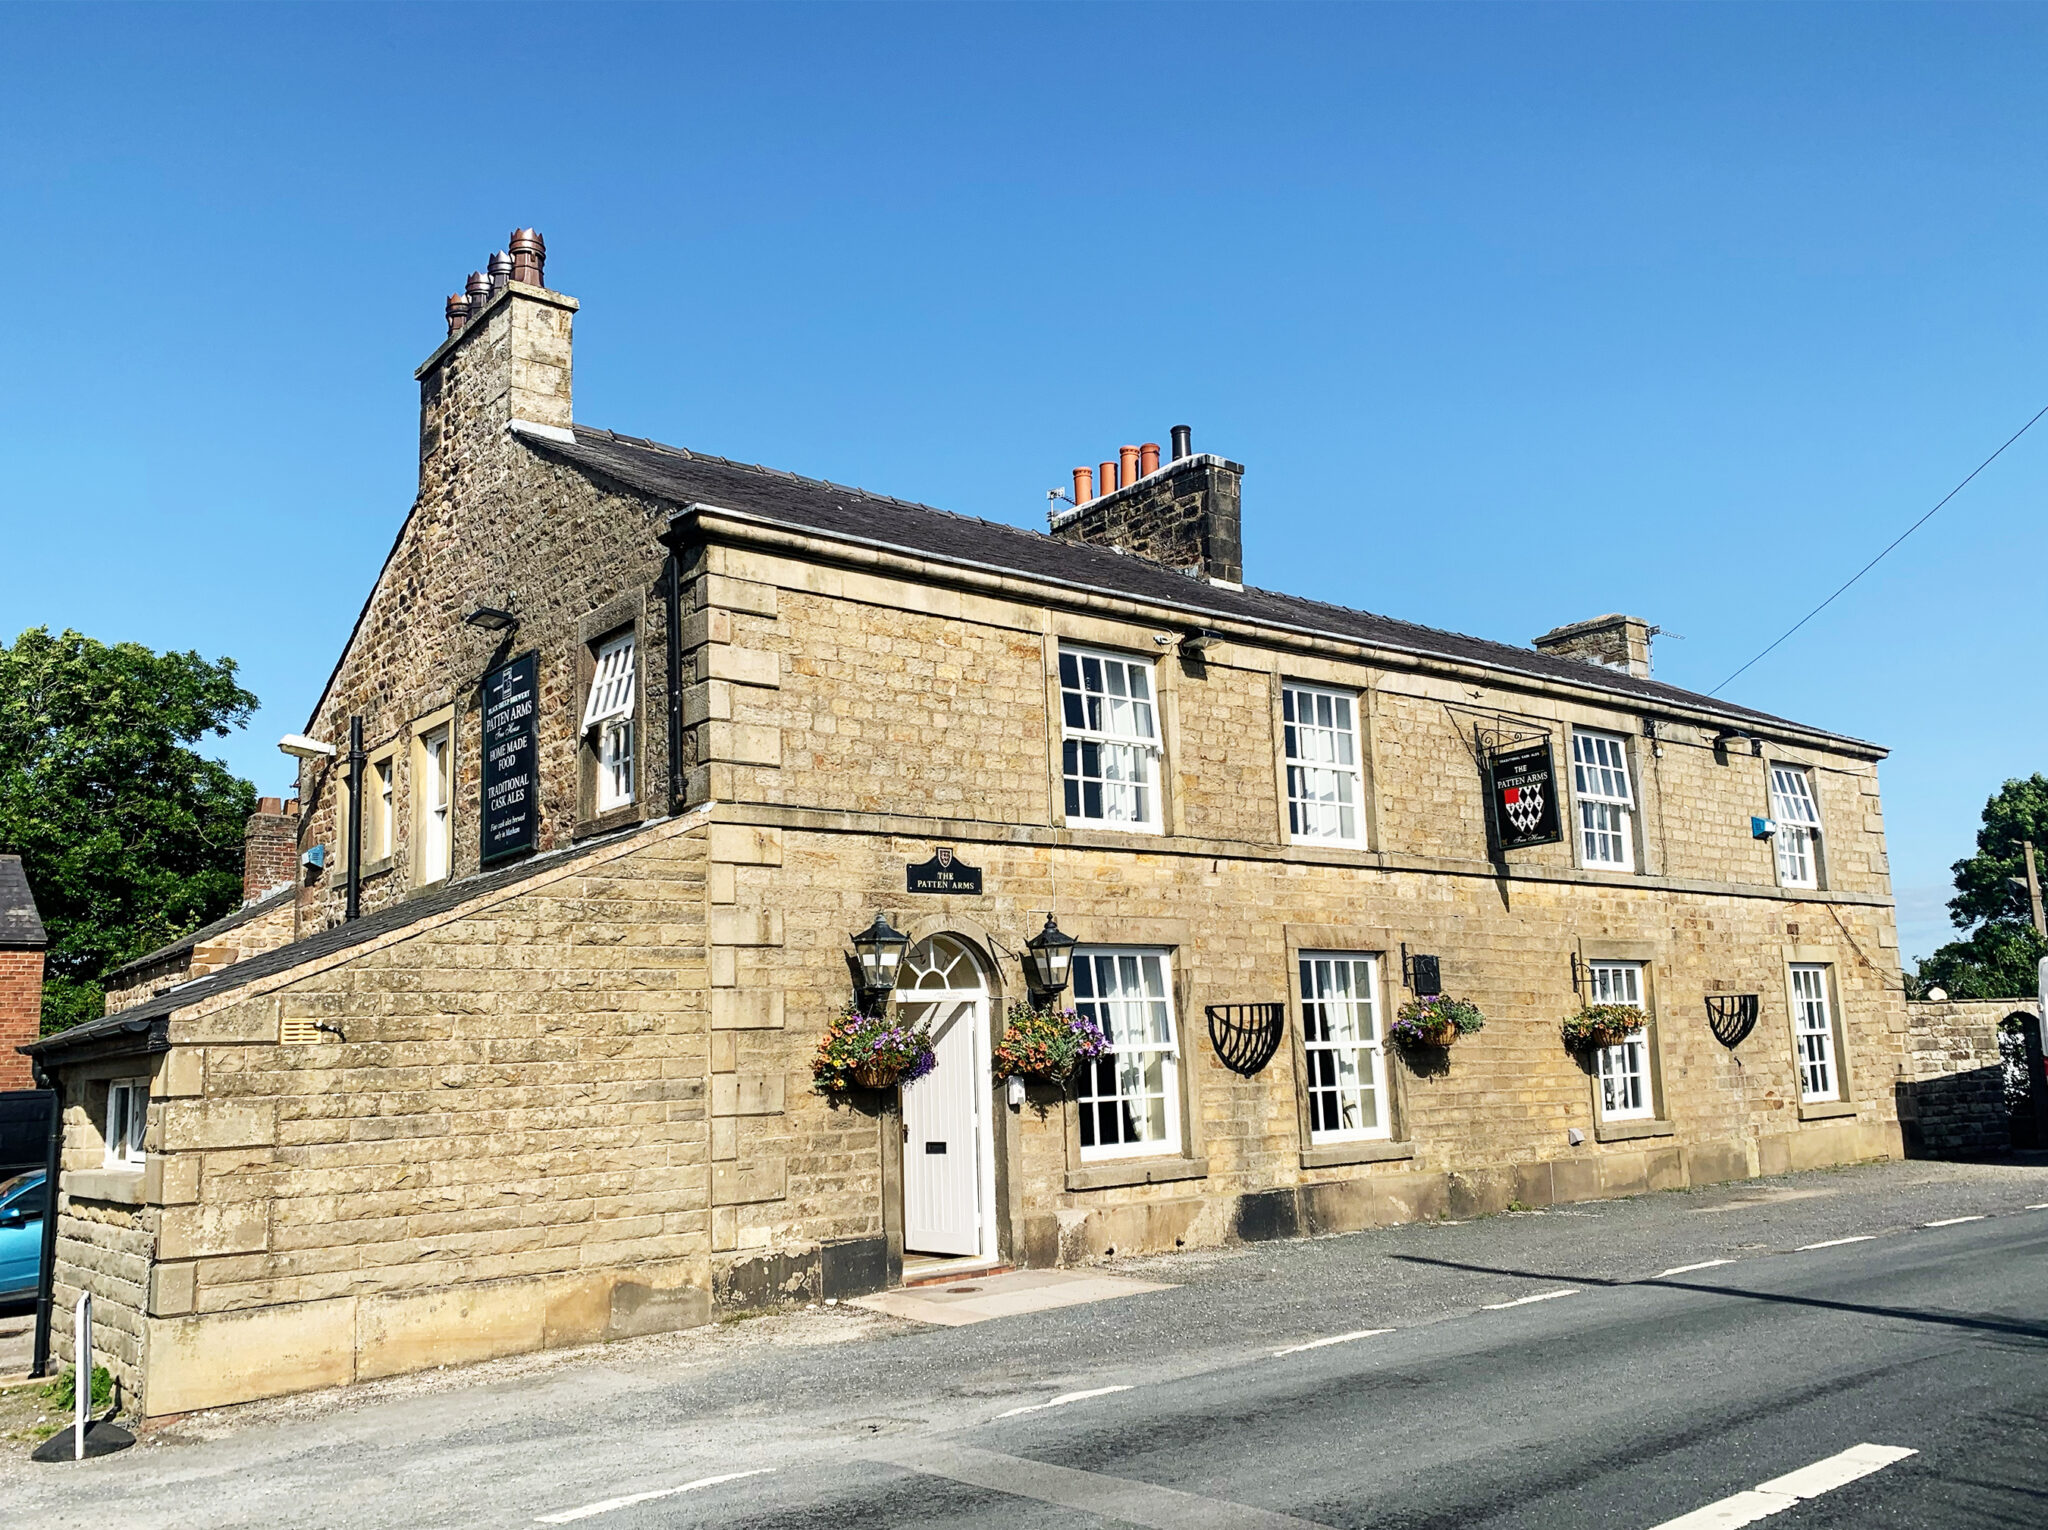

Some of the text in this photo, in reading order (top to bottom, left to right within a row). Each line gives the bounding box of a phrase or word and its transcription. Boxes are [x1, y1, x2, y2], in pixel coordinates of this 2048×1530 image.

[486, 700, 532, 733] PATTEN ARMS
[489, 736, 528, 762] HOME MADE
[498, 754, 516, 772] FOOD
[1514, 764, 1527, 773] THE
[488, 773, 529, 799] TRADITIONAL
[1497, 771, 1548, 789] PATTEN ARMS
[491, 788, 525, 811] CASK ALES
[917, 880, 975, 890] PATTEN ARMS
[937, 872, 954, 880] THE
